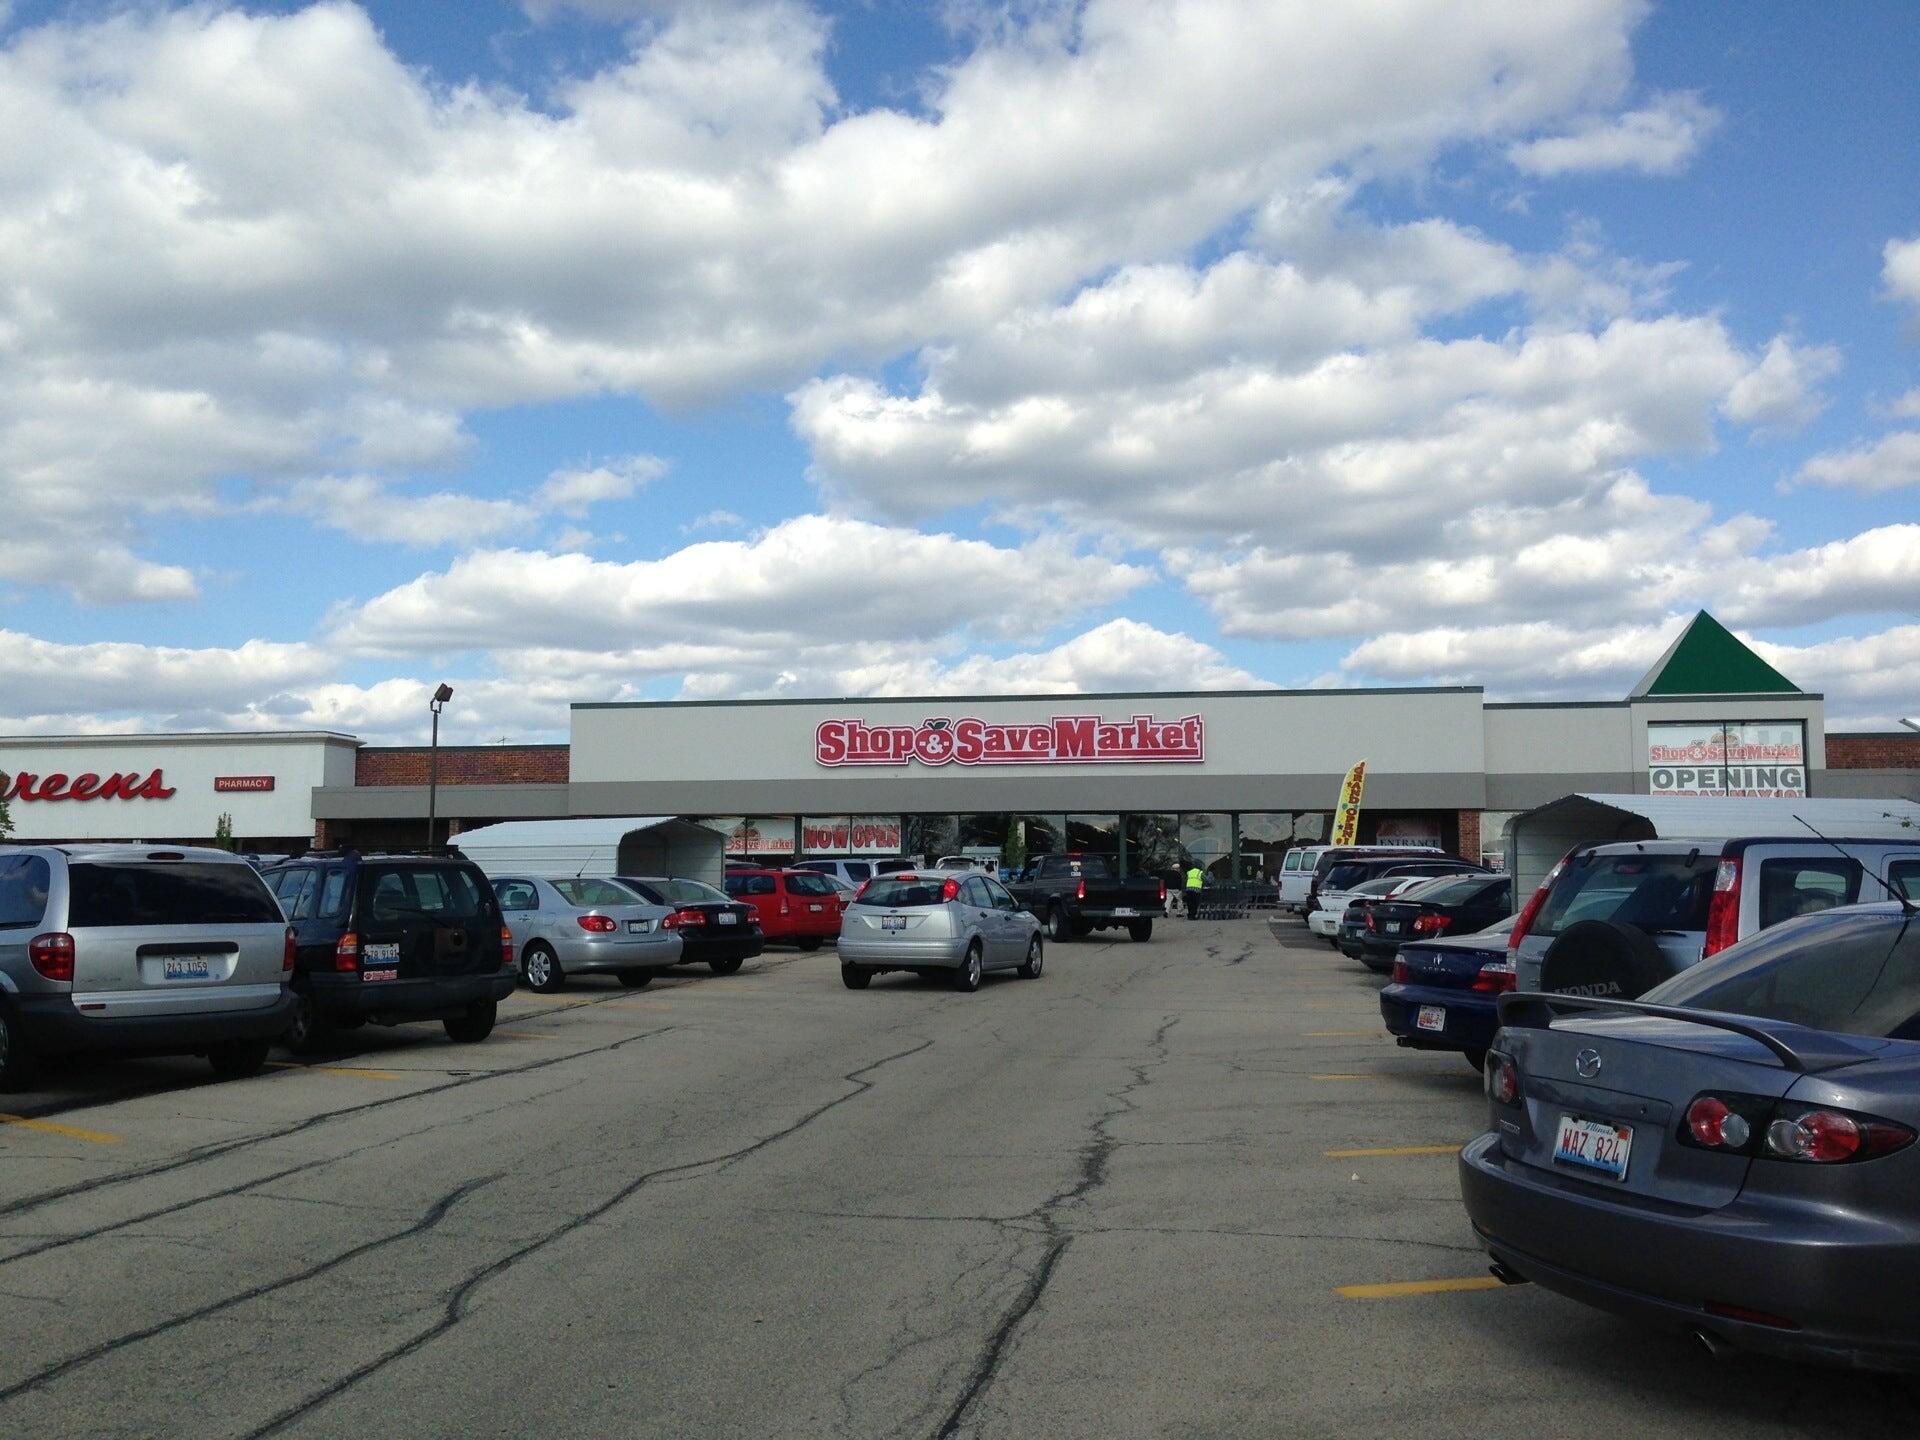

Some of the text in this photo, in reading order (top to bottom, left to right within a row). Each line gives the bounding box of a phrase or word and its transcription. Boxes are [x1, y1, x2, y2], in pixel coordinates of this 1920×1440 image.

[819, 721, 914, 762] Shop
[953, 721, 1051, 762] Save
[1055, 717, 1201, 758] Market
[1652, 746, 1688, 760] Shop
[1706, 746, 1746, 760] Save
[0, 769, 176, 800] reens
[218, 780, 268, 788] PHARMACY
[1652, 768, 1801, 789] OPENING
[803, 823, 900, 849] NOW OPEN
[1380, 838, 1440, 847] ENTRANCE
[1561, 1128, 1619, 1166] WAZ 824
